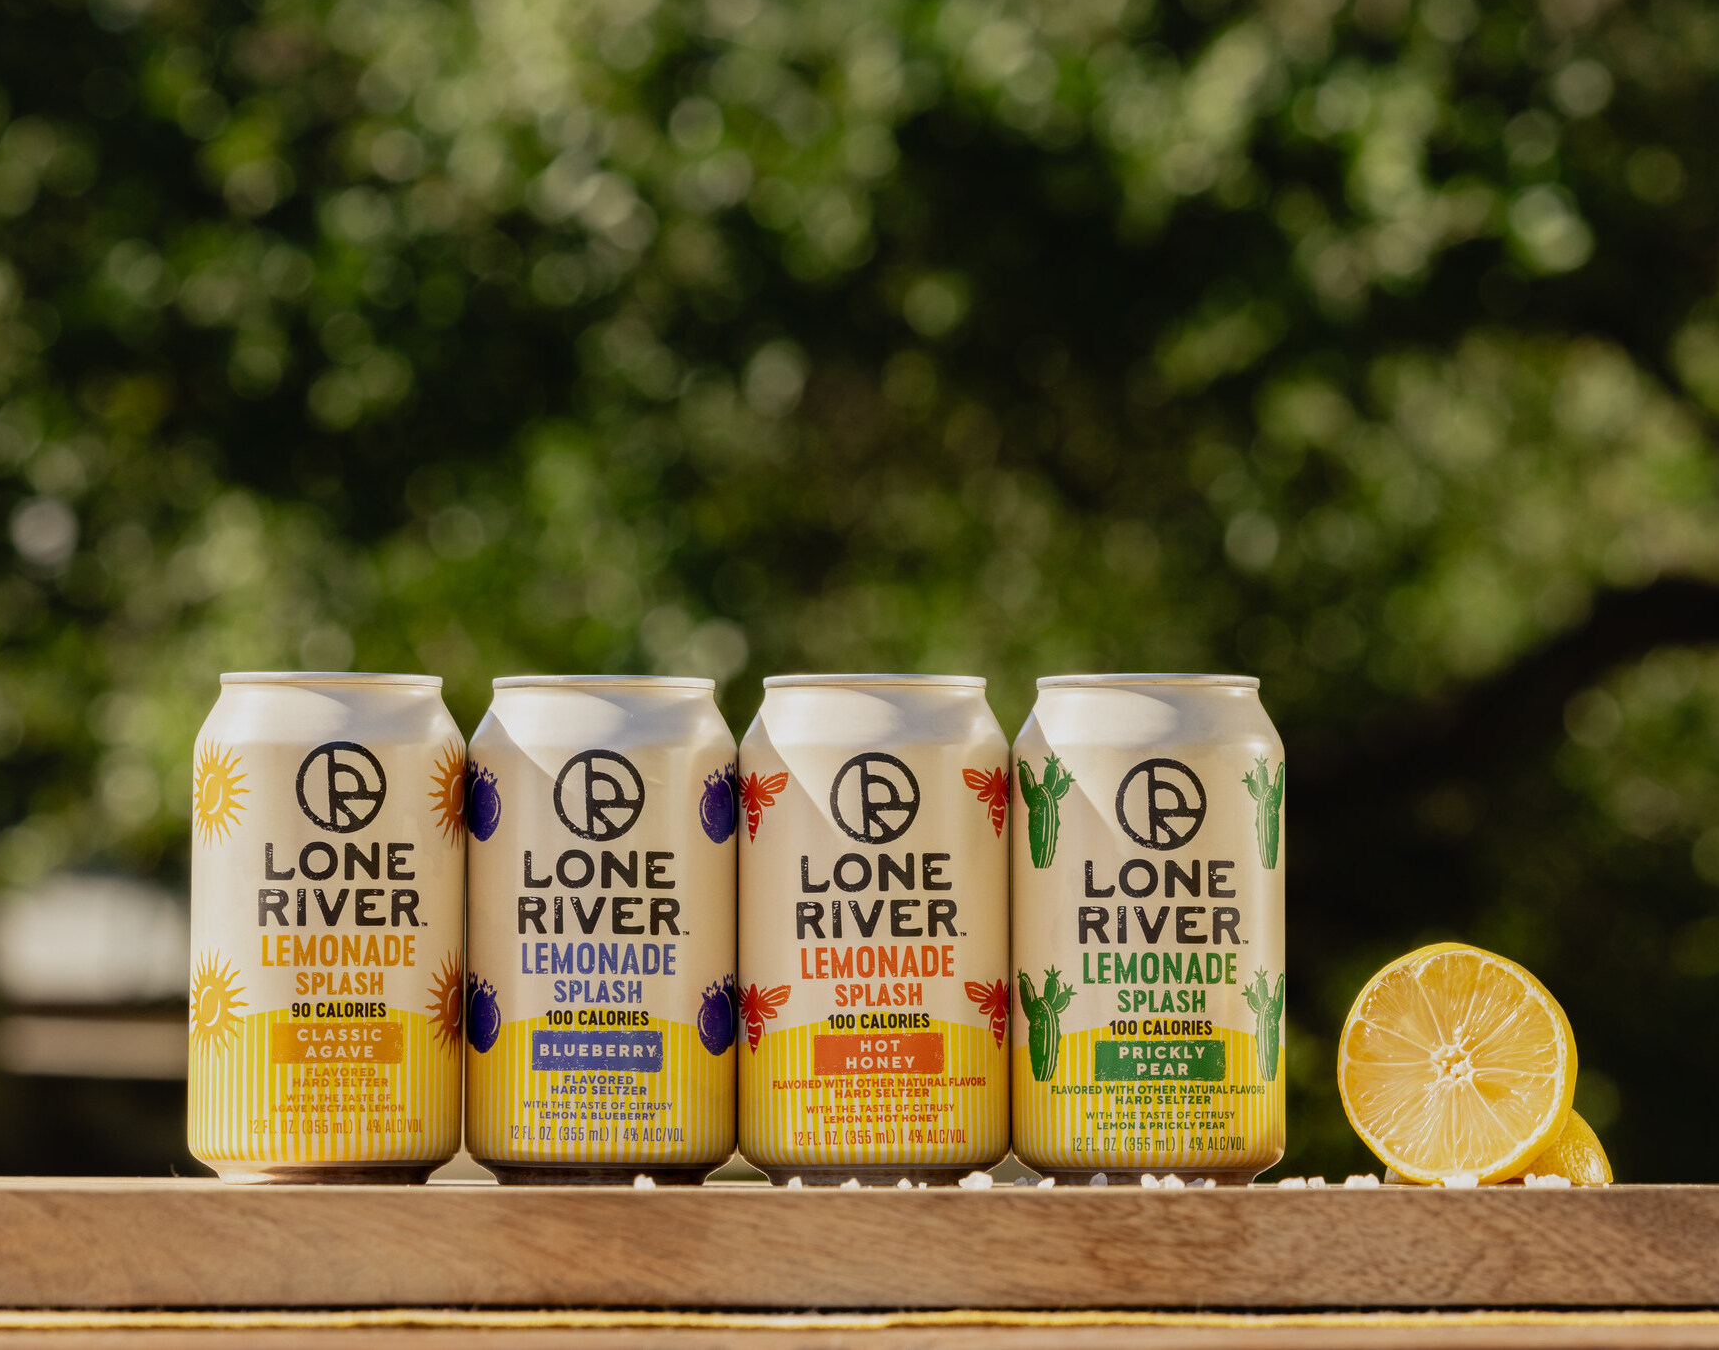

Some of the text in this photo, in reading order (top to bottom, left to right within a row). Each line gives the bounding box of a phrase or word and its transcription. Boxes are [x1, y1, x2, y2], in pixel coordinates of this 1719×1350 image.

[265, 842, 415, 880] LONE
[524, 849, 675, 889] LONE
[801, 853, 952, 893] LONE
[1085, 859, 1236, 898] LONE
[258, 889, 419, 926] RIVER
[518, 897, 680, 935] RIVER
[796, 900, 958, 939] RIVER
[1078, 906, 1240, 945] RIVER
[262, 935, 415, 966] LEMONADE
[522, 942, 676, 975] LEMONADE
[801, 945, 954, 979] LEMONADE
[1083, 952, 1236, 984] LEMONADE
[296, 972, 383, 995] SPLASH
[554, 980, 642, 1003] SPLASH
[835, 983, 922, 1007] SPLASH
[1118, 990, 1206, 1013] SPLASH
[292, 1002, 386, 1018] 90 CALORIES
[546, 1010, 649, 1026] 100 CALORIES
[828, 1013, 930, 1029] 100 CALORIES
[297, 1028, 382, 1041] CLASSIC
[1109, 1020, 1212, 1035] 100 CALORIES
[305, 1046, 374, 1058] AGAVE
[540, 1044, 657, 1057] BLUEBERRY
[861, 1040, 900, 1052] HOT
[1119, 1047, 1205, 1059] PRICKLY
[846, 1056, 915, 1069] HONEY
[1137, 1063, 1189, 1075] PEAR
[306, 1068, 376, 1077] FLAVORED
[564, 1075, 634, 1084] FLAVORED
[293, 1078, 389, 1087] HARD SELTZER
[773, 1077, 986, 1089] FLAVORED WITH OTHER NATURAL FLAVORS
[1051, 1085, 1265, 1094] FLAVORED WITH OTHER NATURAL FLAVORS
[286, 1094, 391, 1102] WITH THE TASTE OF
[551, 1086, 647, 1095] HARD SELTZER
[835, 1088, 930, 1098] HARD SELTZER
[629, 1102, 673, 1110] CITRUSY
[1115, 1096, 1211, 1105] HARD SELTZER
[581, 1112, 587, 1120] &
[591, 1112, 655, 1120] BLUEBERRY
[806, 1106, 832, 1114] WITH
[836, 1105, 856, 1113] THE
[859, 1105, 892, 1113] TASTE
[913, 1104, 954, 1112] CITRUSY
[1086, 1112, 1113, 1120] WITH
[263, 1120, 277, 1134] FL.
[282, 1121, 297, 1134] OZ.
[302, 1120, 328, 1134] (355
[367, 1119, 380, 1133] 4%
[385, 1118, 423, 1133] ALC/VOL
[824, 1115, 939, 1124] LEMON & HOT HONEY
[1097, 1122, 1136, 1130] LEMON
[1139, 1122, 1146, 1130] &
[1150, 1122, 1196, 1130] PRICKLY
[511, 1126, 519, 1139] 12
[523, 1126, 535, 1140] FL.
[539, 1126, 554, 1141] OZ.
[559, 1126, 584, 1142] (355
[623, 1128, 639, 1141] 4%
[643, 1128, 684, 1142] ALC/VOL
[795, 1132, 803, 1146] 12
[808, 1132, 821, 1146] FL.
[825, 1132, 841, 1145] OZ.
[845, 1131, 871, 1145] (355
[908, 1130, 923, 1144] 4%
[927, 1129, 966, 1144] ALC/VOL
[1073, 1137, 1081, 1151] 12
[1086, 1137, 1100, 1151] FL.
[1104, 1137, 1119, 1151] OZ.
[1125, 1138, 1151, 1152] (355
[1189, 1137, 1203, 1151] 4%
[1208, 1137, 1245, 1151] ALC/VOL
